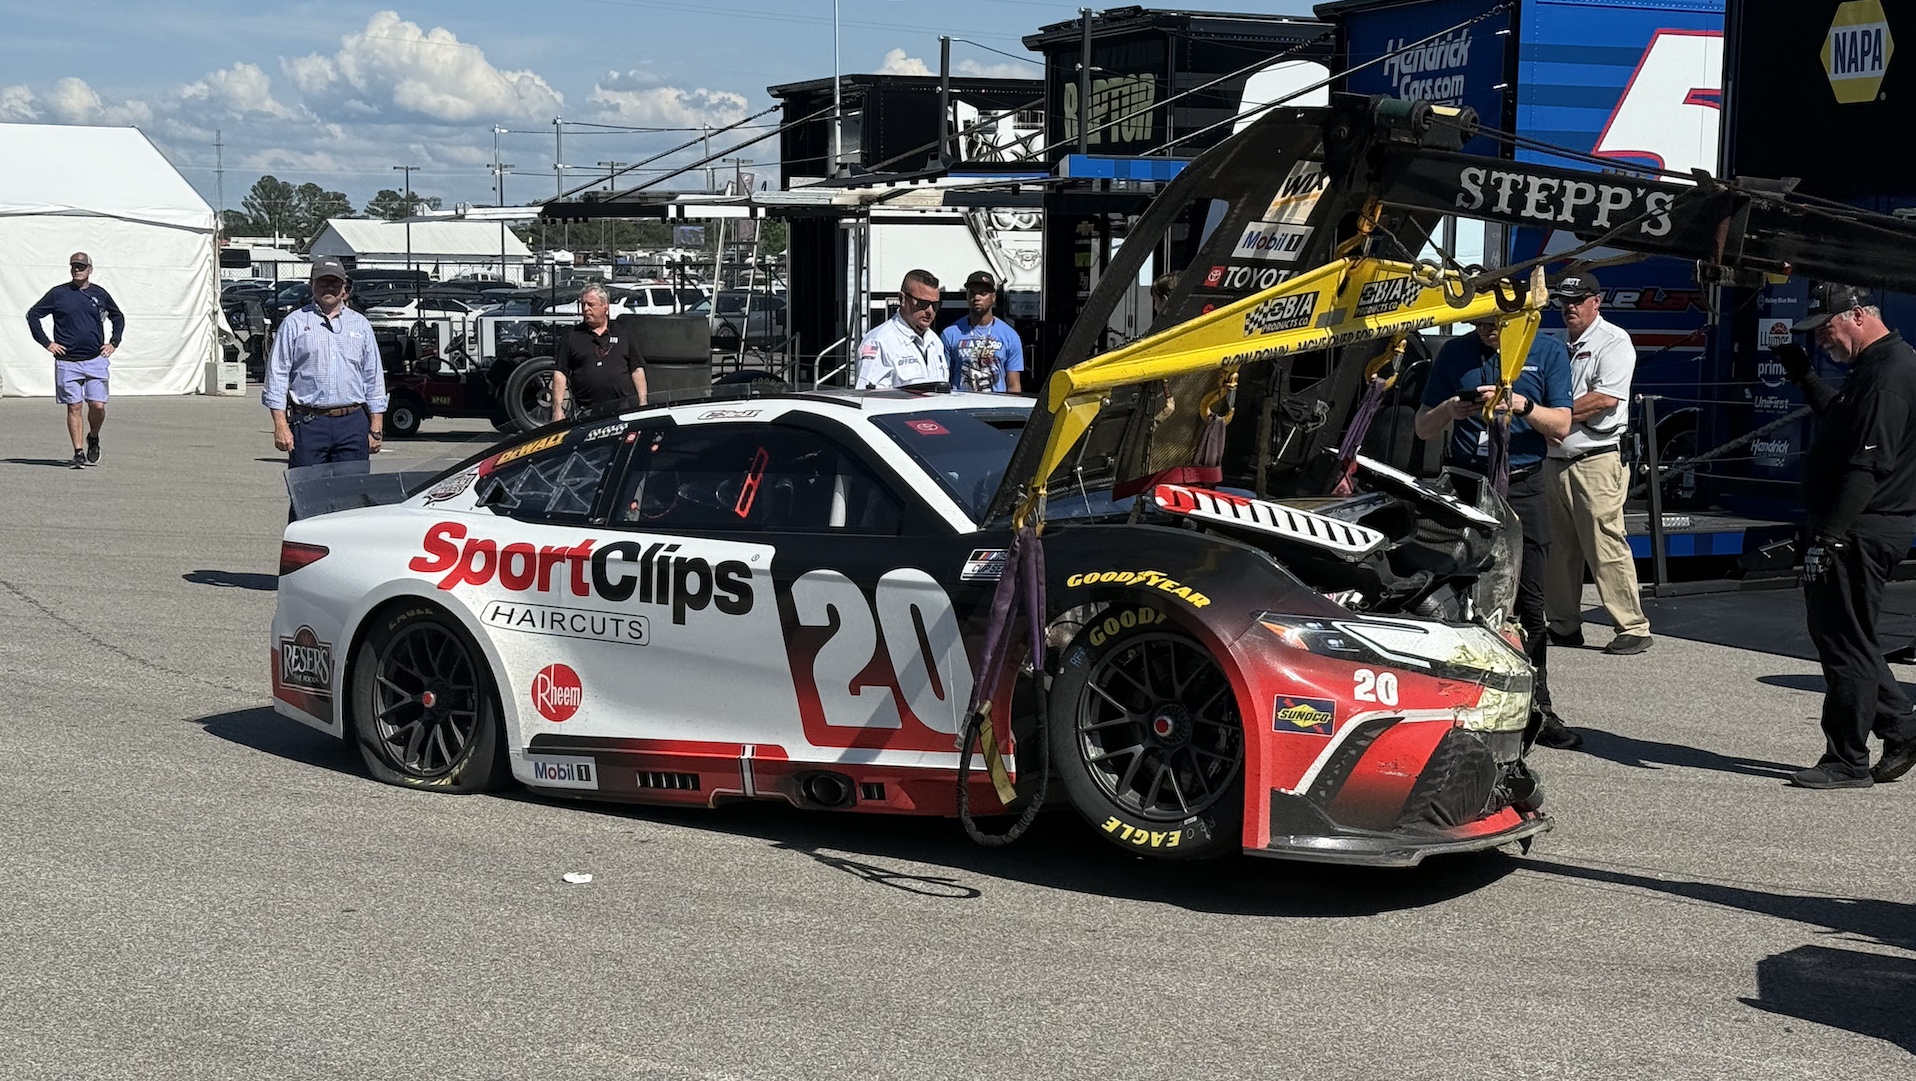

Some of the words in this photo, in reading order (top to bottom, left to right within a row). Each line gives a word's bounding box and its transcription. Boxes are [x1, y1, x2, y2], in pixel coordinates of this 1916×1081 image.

[1383, 28, 1473, 87] Hendrick
[1833, 34, 1883, 74] NAPA
[1400, 75, 1464, 102] Cars.com
[1064, 73, 1155, 146] RAPTOR
[1281, 172, 1325, 198] WIX
[1455, 166, 1675, 237] STEPP'S
[1242, 231, 1289, 251] Mobil
[1285, 234, 1305, 251] 1
[1261, 319, 1298, 333] PRODUCTS
[1356, 303, 1387, 315] PRODUCTS
[1750, 439, 1789, 455] Hendrick
[1066, 570, 1211, 608] GOODYEAR
[490, 605, 643, 639] HAIRCUTS
[1089, 607, 1168, 647] GOOD
[284, 644, 329, 684] RESER'S
[791, 568, 976, 735] 20
[537, 664, 581, 714] Rheem
[1353, 668, 1398, 706] 20
[1280, 709, 1330, 722] SUNOCO
[534, 761, 575, 780] Mobil
[577, 764, 592, 781] 1
[1101, 816, 1182, 848] EAGLE
